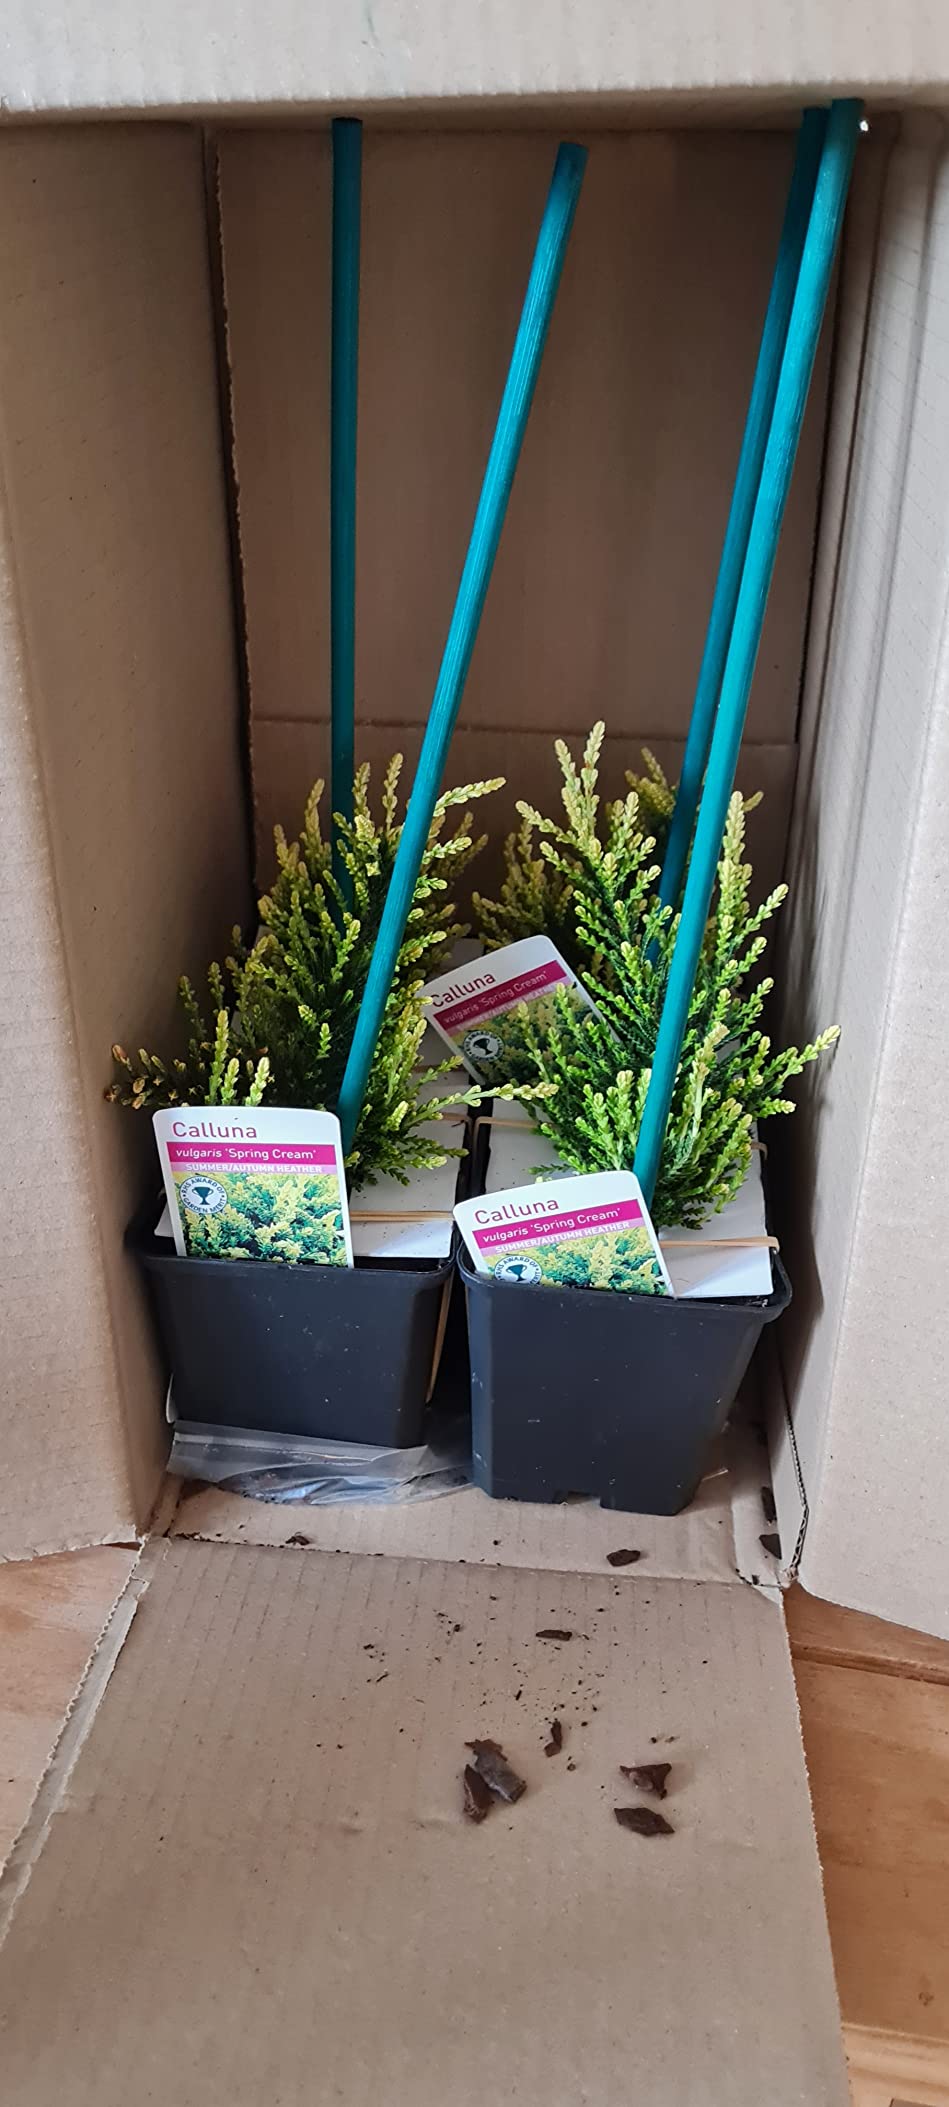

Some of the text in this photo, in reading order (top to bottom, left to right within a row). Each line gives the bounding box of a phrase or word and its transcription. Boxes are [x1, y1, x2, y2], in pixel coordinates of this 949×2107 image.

[444, 1004, 479, 1024] vulgaris
[172, 1121, 257, 1138] Calluna
[175, 1148, 317, 1160] vulgaris 'Spring Cream'
[185, 1163, 323, 1174] SUMMER/AUTUMN HEATHER
[191, 1177, 218, 1188] AWARD
[474, 1199, 559, 1225] Calluna
[482, 1207, 621, 1243] vulgaris 'Spring Cream'
[495, 1221, 630, 1254] SUMMER/AUTUMN HEATHER
[503, 1256, 530, 1265] AWARD
